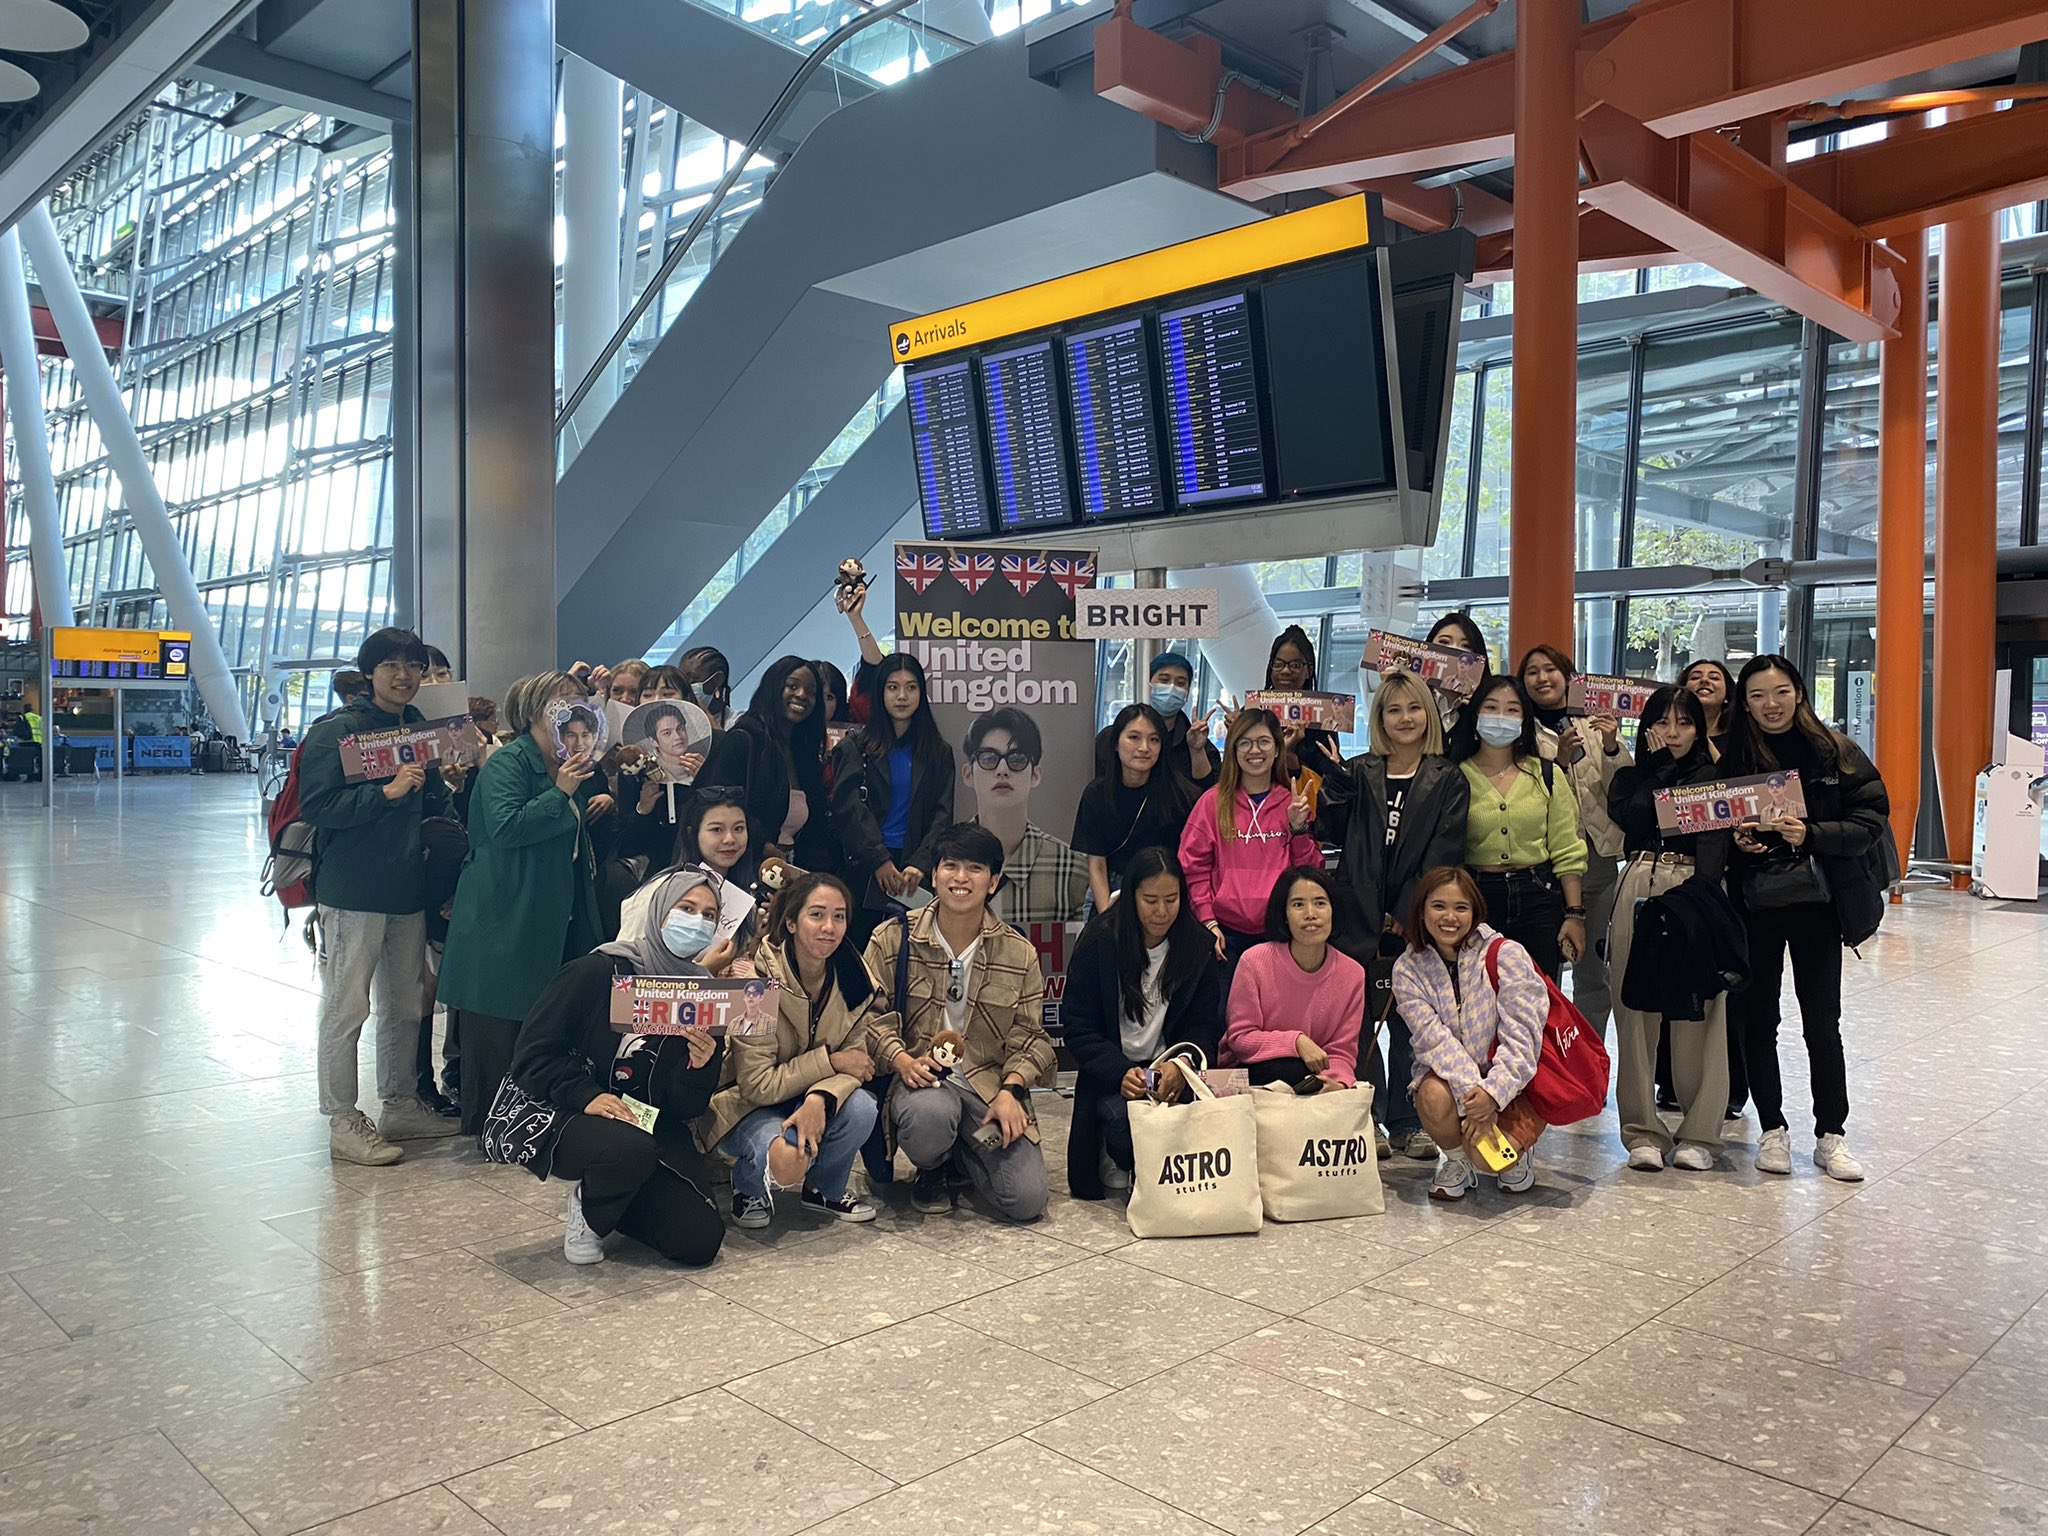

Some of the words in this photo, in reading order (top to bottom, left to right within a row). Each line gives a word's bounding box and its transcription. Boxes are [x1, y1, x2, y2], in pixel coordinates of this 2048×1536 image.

[914, 319, 966, 347] Arrivals
[1087, 604, 1209, 627] BRIGHT
[899, 611, 1051, 639] Welcome
[1384, 634, 1419, 648] Welcome
[899, 640, 1031, 672] United
[1383, 640, 1410, 652] United
[1410, 646, 1449, 662] Kingdom
[1587, 675, 1625, 685] Welcome
[1587, 682, 1615, 691] United
[926, 671, 1077, 713] ingdom
[1287, 697, 1322, 706] Kingdom
[1598, 691, 1649, 712] RIGH
[357, 729, 400, 742] Welcome
[401, 727, 411, 735] to
[359, 737, 393, 750] United
[394, 731, 437, 745] Kingdom
[141, 749, 183, 758] NERO
[1672, 784, 1715, 798] Welcome
[1716, 782, 1727, 791] to
[1674, 792, 1708, 805] United
[1709, 786, 1755, 800] Kingdom
[635, 979, 686, 990] Welcome
[687, 980, 699, 990] to
[635, 989, 674, 999] United
[677, 989, 729, 1001] Kingdom
[1298, 1135, 1368, 1167] ASTRO
[1158, 1147, 1231, 1185] ASTRO
[1317, 1167, 1357, 1178] stuffs
[1176, 1182, 1218, 1195] stuffs
